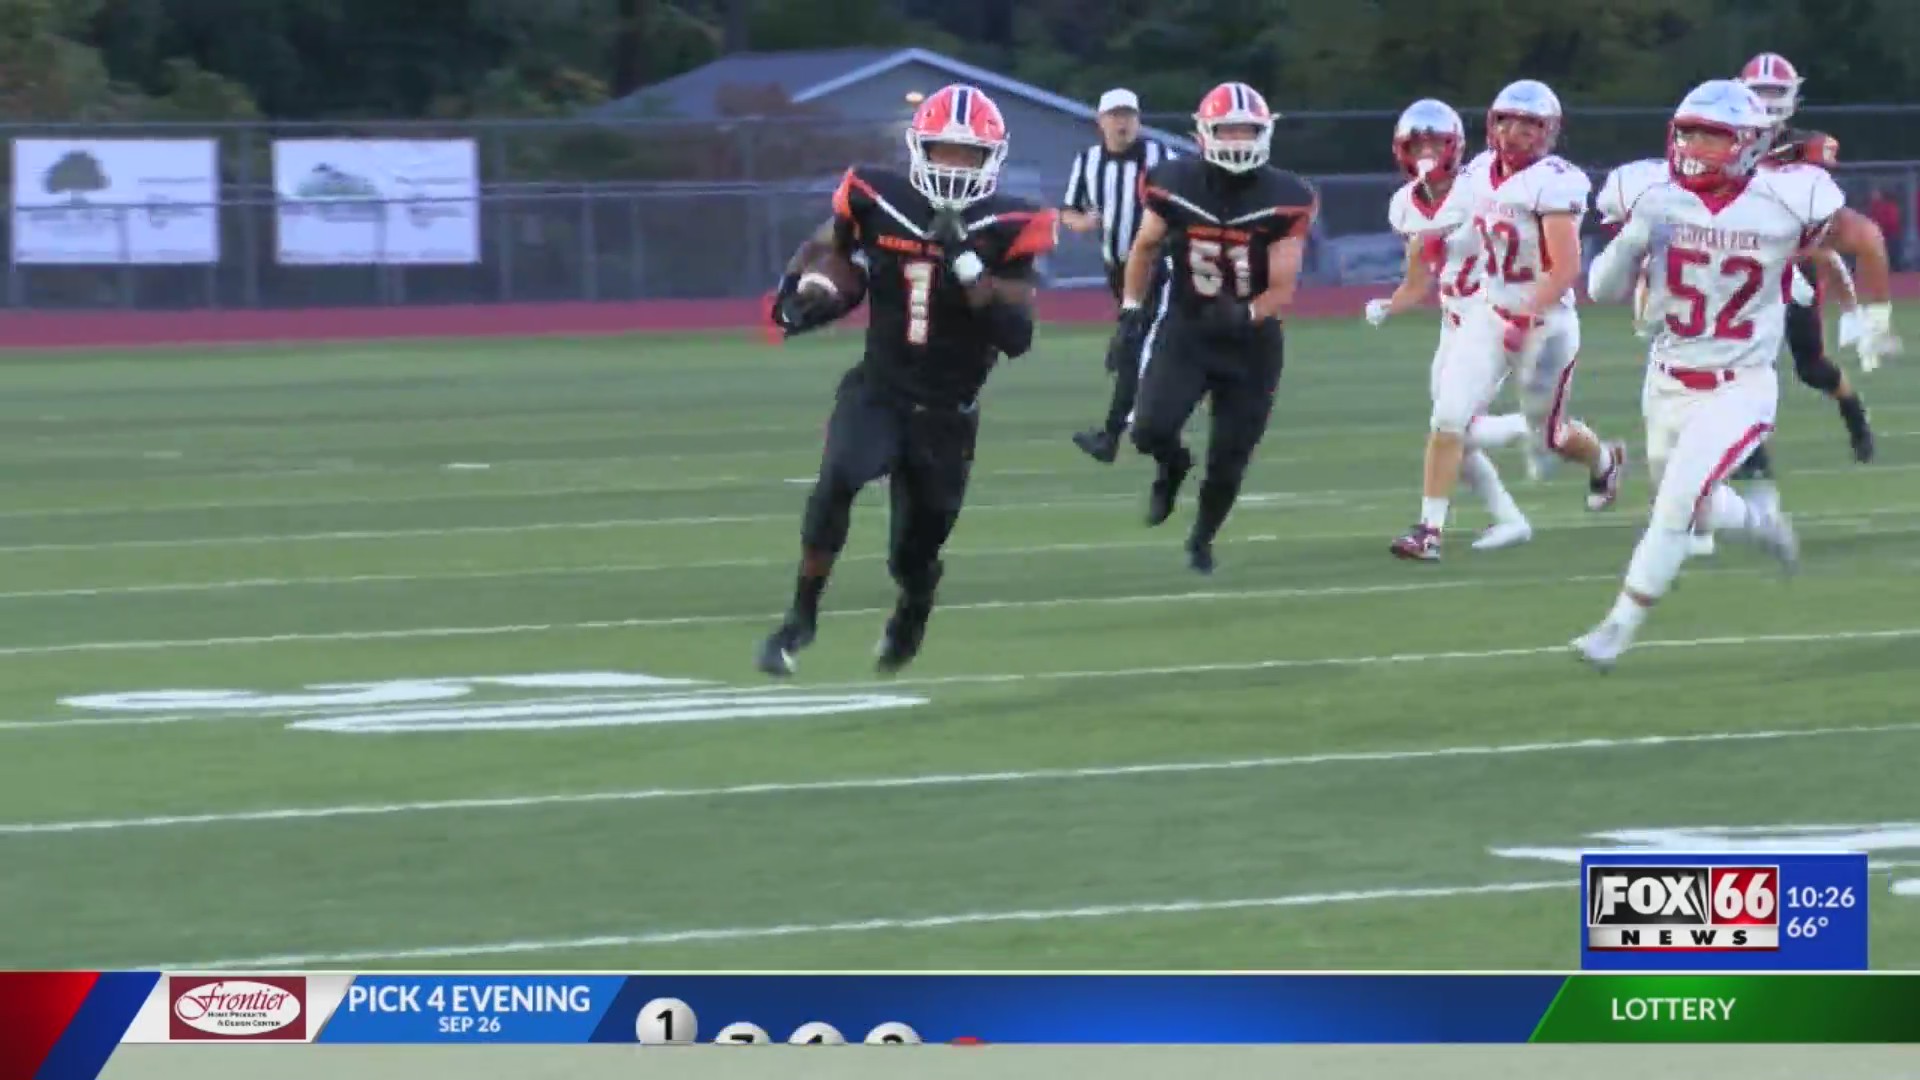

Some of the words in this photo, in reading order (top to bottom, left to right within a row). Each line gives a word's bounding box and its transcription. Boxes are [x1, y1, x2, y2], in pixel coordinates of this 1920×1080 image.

[903, 260, 932, 345] 1
[1189, 238, 1251, 298] 51
[1665, 246, 1763, 339] 52
